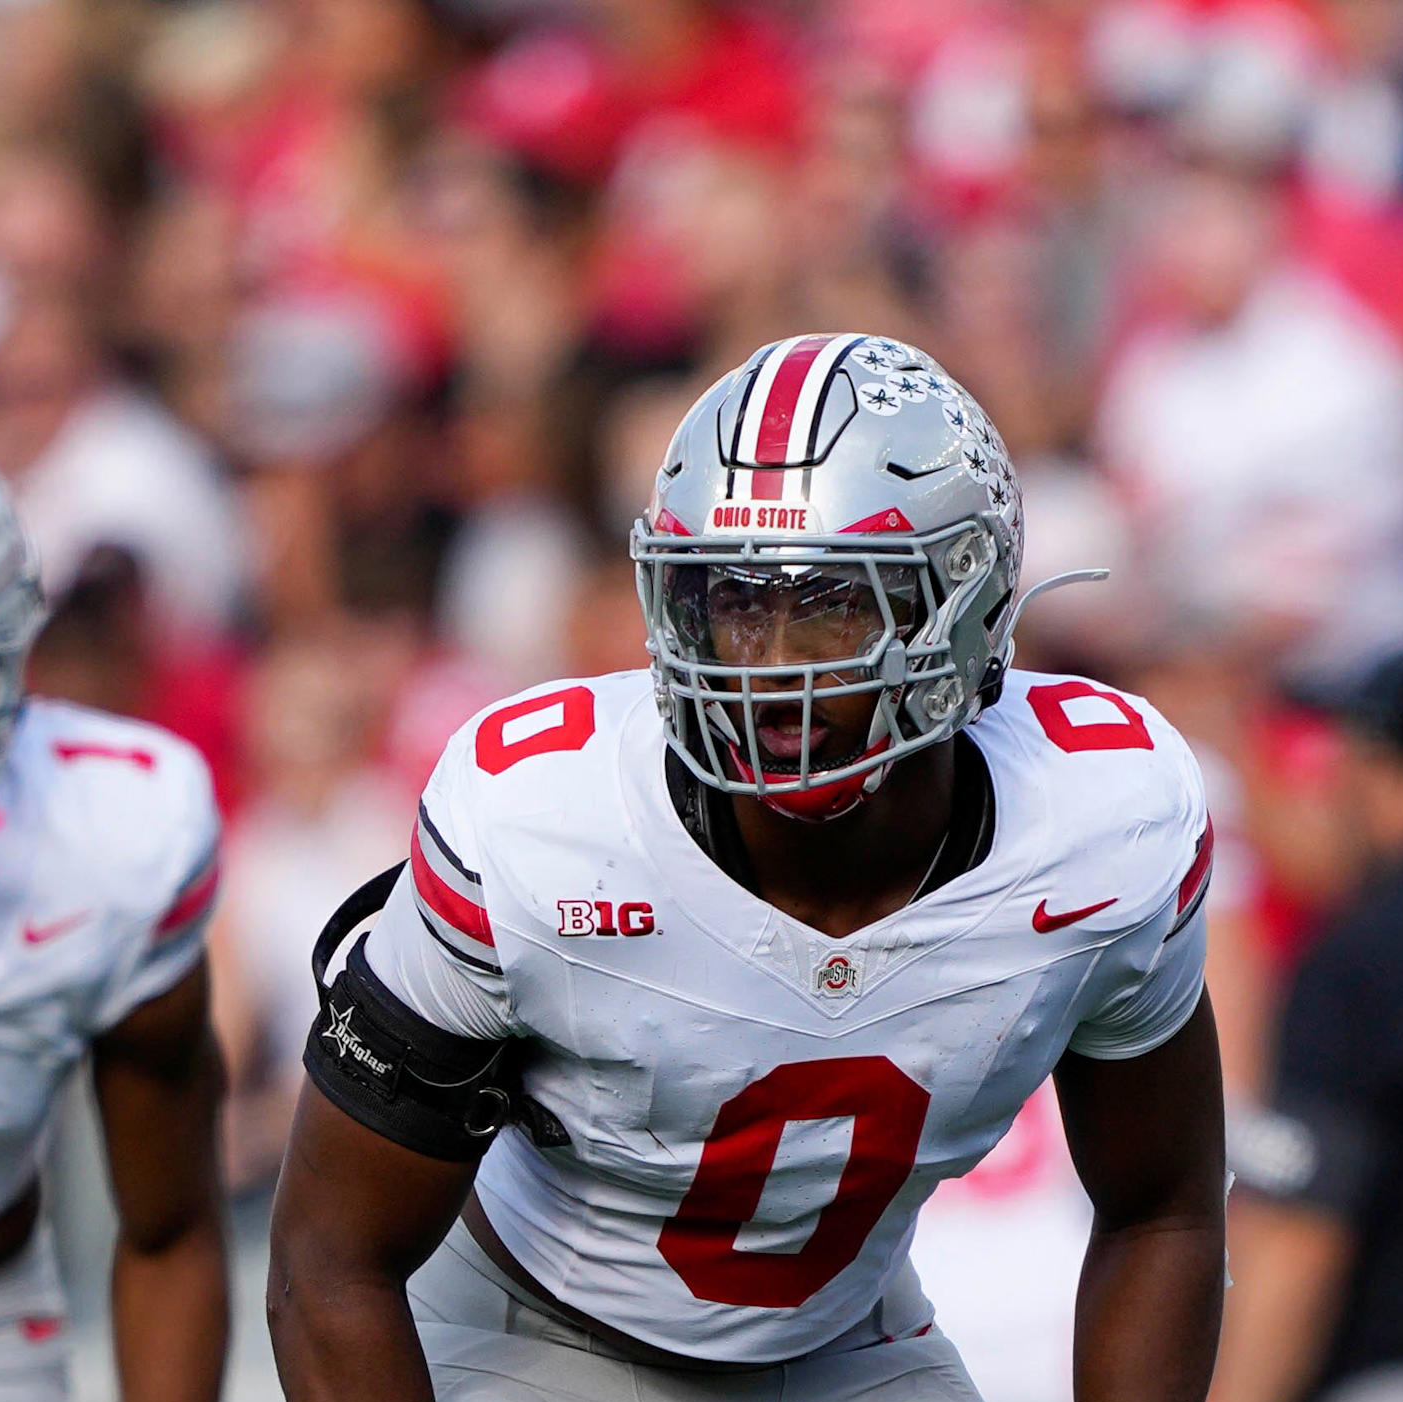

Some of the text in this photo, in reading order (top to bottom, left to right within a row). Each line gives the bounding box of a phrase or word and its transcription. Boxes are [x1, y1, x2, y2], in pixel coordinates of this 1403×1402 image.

[713, 506, 807, 530] OHIO STATE
[475, 685, 596, 777] 0
[1025, 681, 1155, 753] 0
[335, 1021, 388, 1075] Douglas
[657, 1055, 932, 1309] 0
